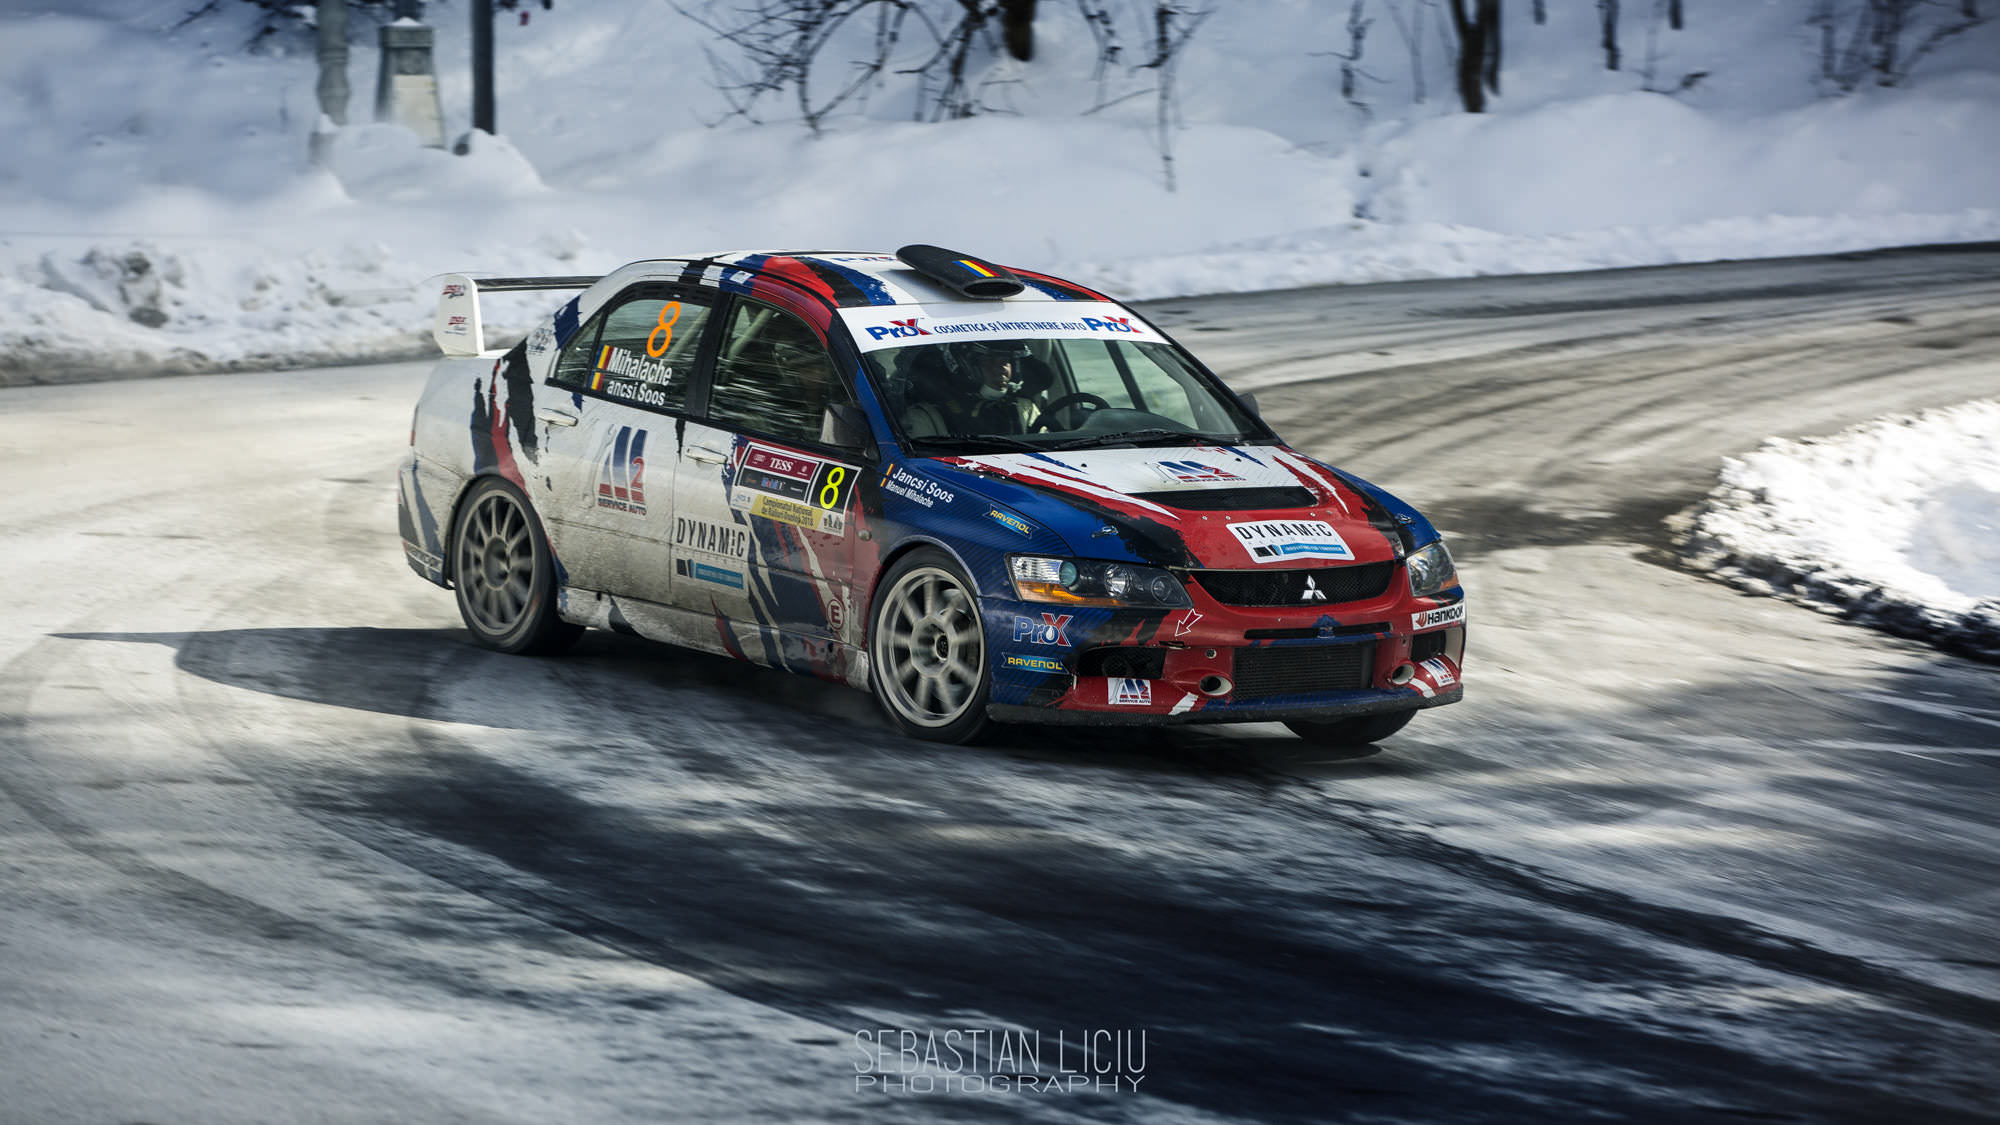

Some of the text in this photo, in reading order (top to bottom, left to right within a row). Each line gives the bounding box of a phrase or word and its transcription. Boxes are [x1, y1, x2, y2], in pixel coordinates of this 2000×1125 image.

[647, 300, 681, 358] 8
[865, 318, 933, 340] ProX
[934, 322, 988, 334] COSMETICA
[1061, 321, 1087, 331] AUTO
[1081, 315, 1144, 333] ProX
[607, 347, 672, 386] Mihalache
[637, 383, 666, 406] Soos
[769, 457, 794, 472] TESS
[820, 466, 845, 510] 8
[892, 467, 955, 503] Jancsi Soos
[598, 497, 648, 516] SERVICE AUTO
[989, 509, 1032, 534] RAVENOL
[1013, 612, 1074, 647] ProX
[1007, 656, 1063, 671] RAVENOL
